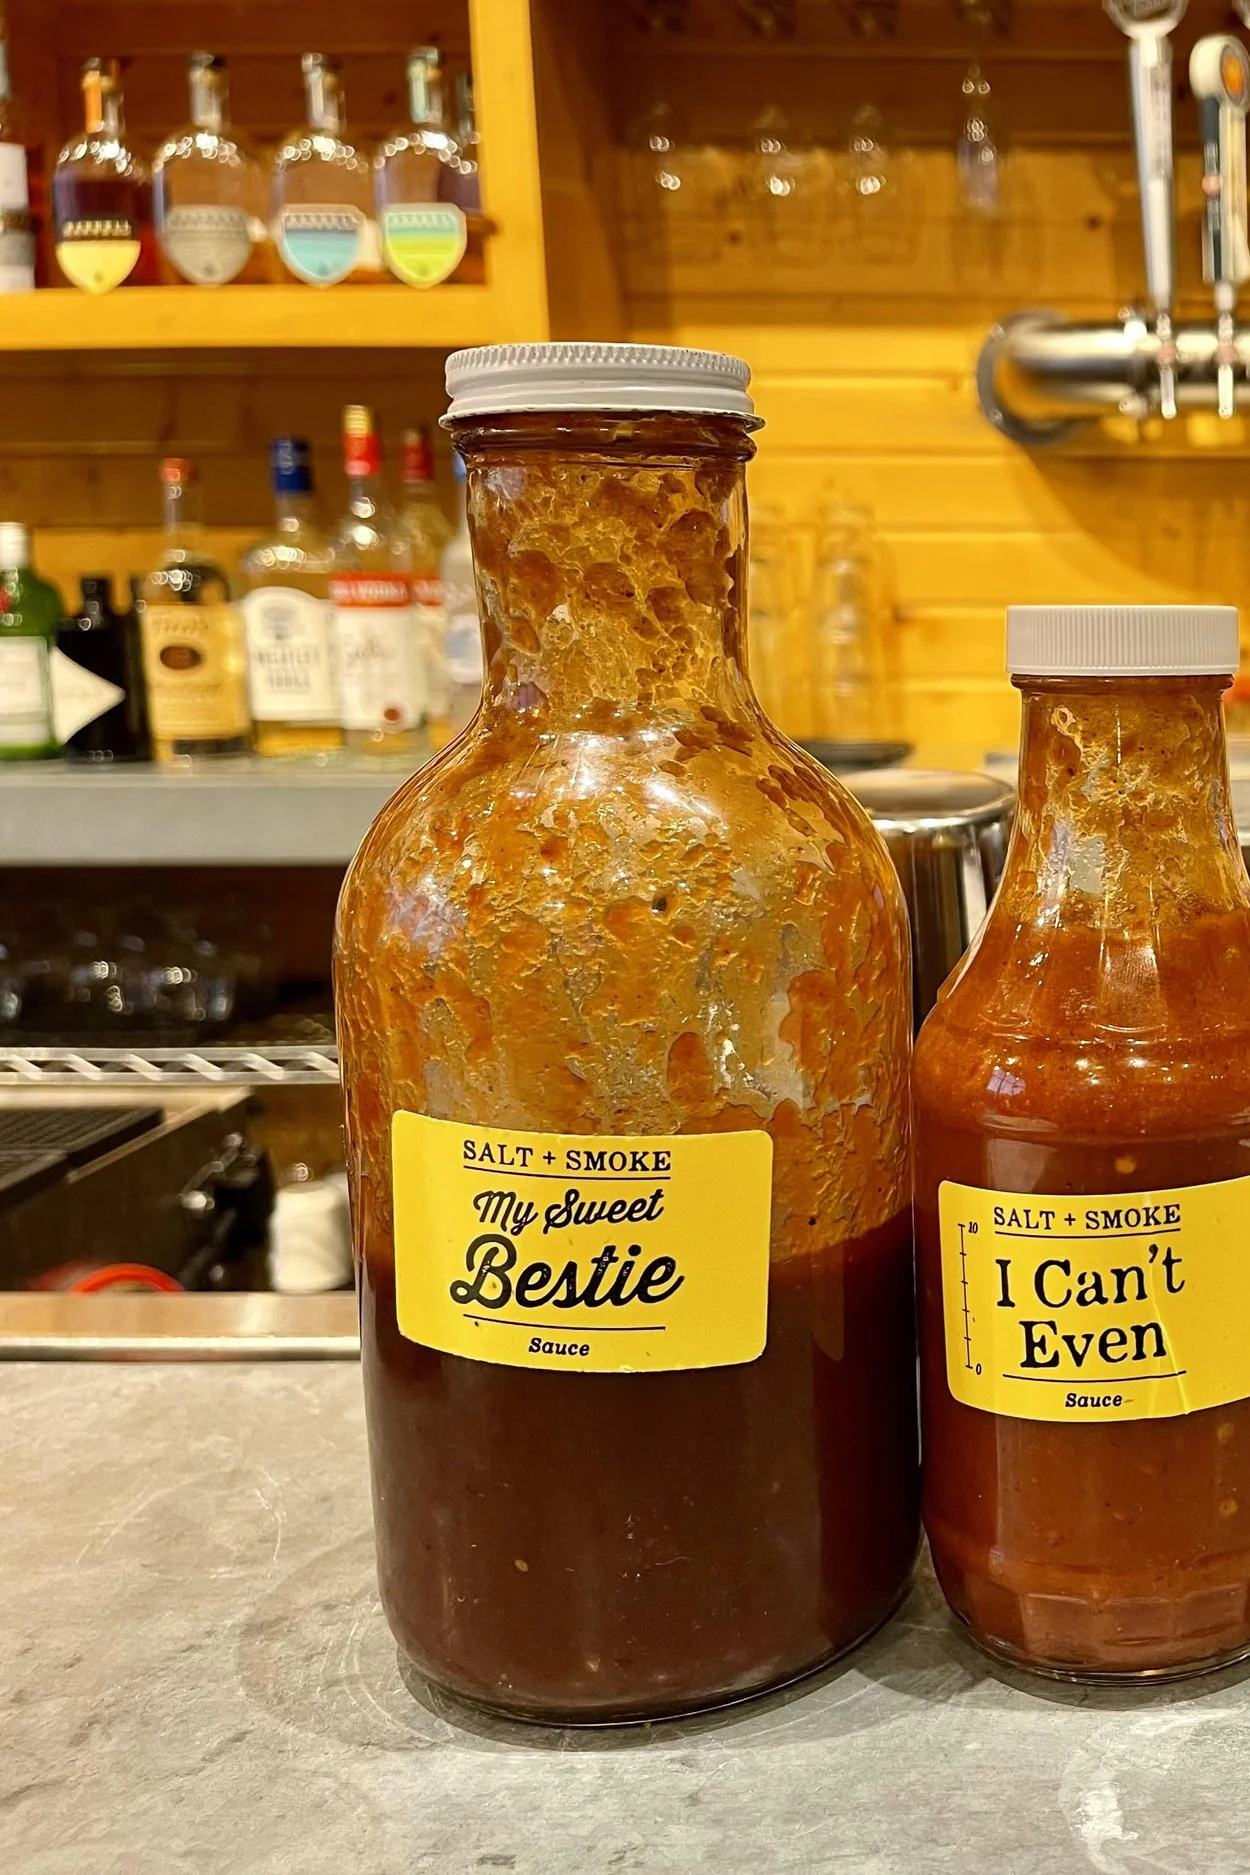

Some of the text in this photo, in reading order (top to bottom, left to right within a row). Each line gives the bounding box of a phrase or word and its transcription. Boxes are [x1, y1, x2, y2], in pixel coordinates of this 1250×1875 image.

[463, 1139, 534, 1168] SALT
[565, 1149, 671, 1172] SMOKE
[472, 1188, 665, 1236] My Sweet
[968, 1220, 979, 1234] 10
[993, 1206, 1056, 1230] SALT
[1085, 1203, 1182, 1231] SMOKE
[449, 1232, 685, 1310] Bestie
[995, 1243, 1186, 1309] I Can't
[528, 1337, 590, 1357] Sauce
[1018, 1320, 1167, 1369] Even
[975, 1363, 983, 1376] 0
[1065, 1392, 1123, 1408] Sauce
